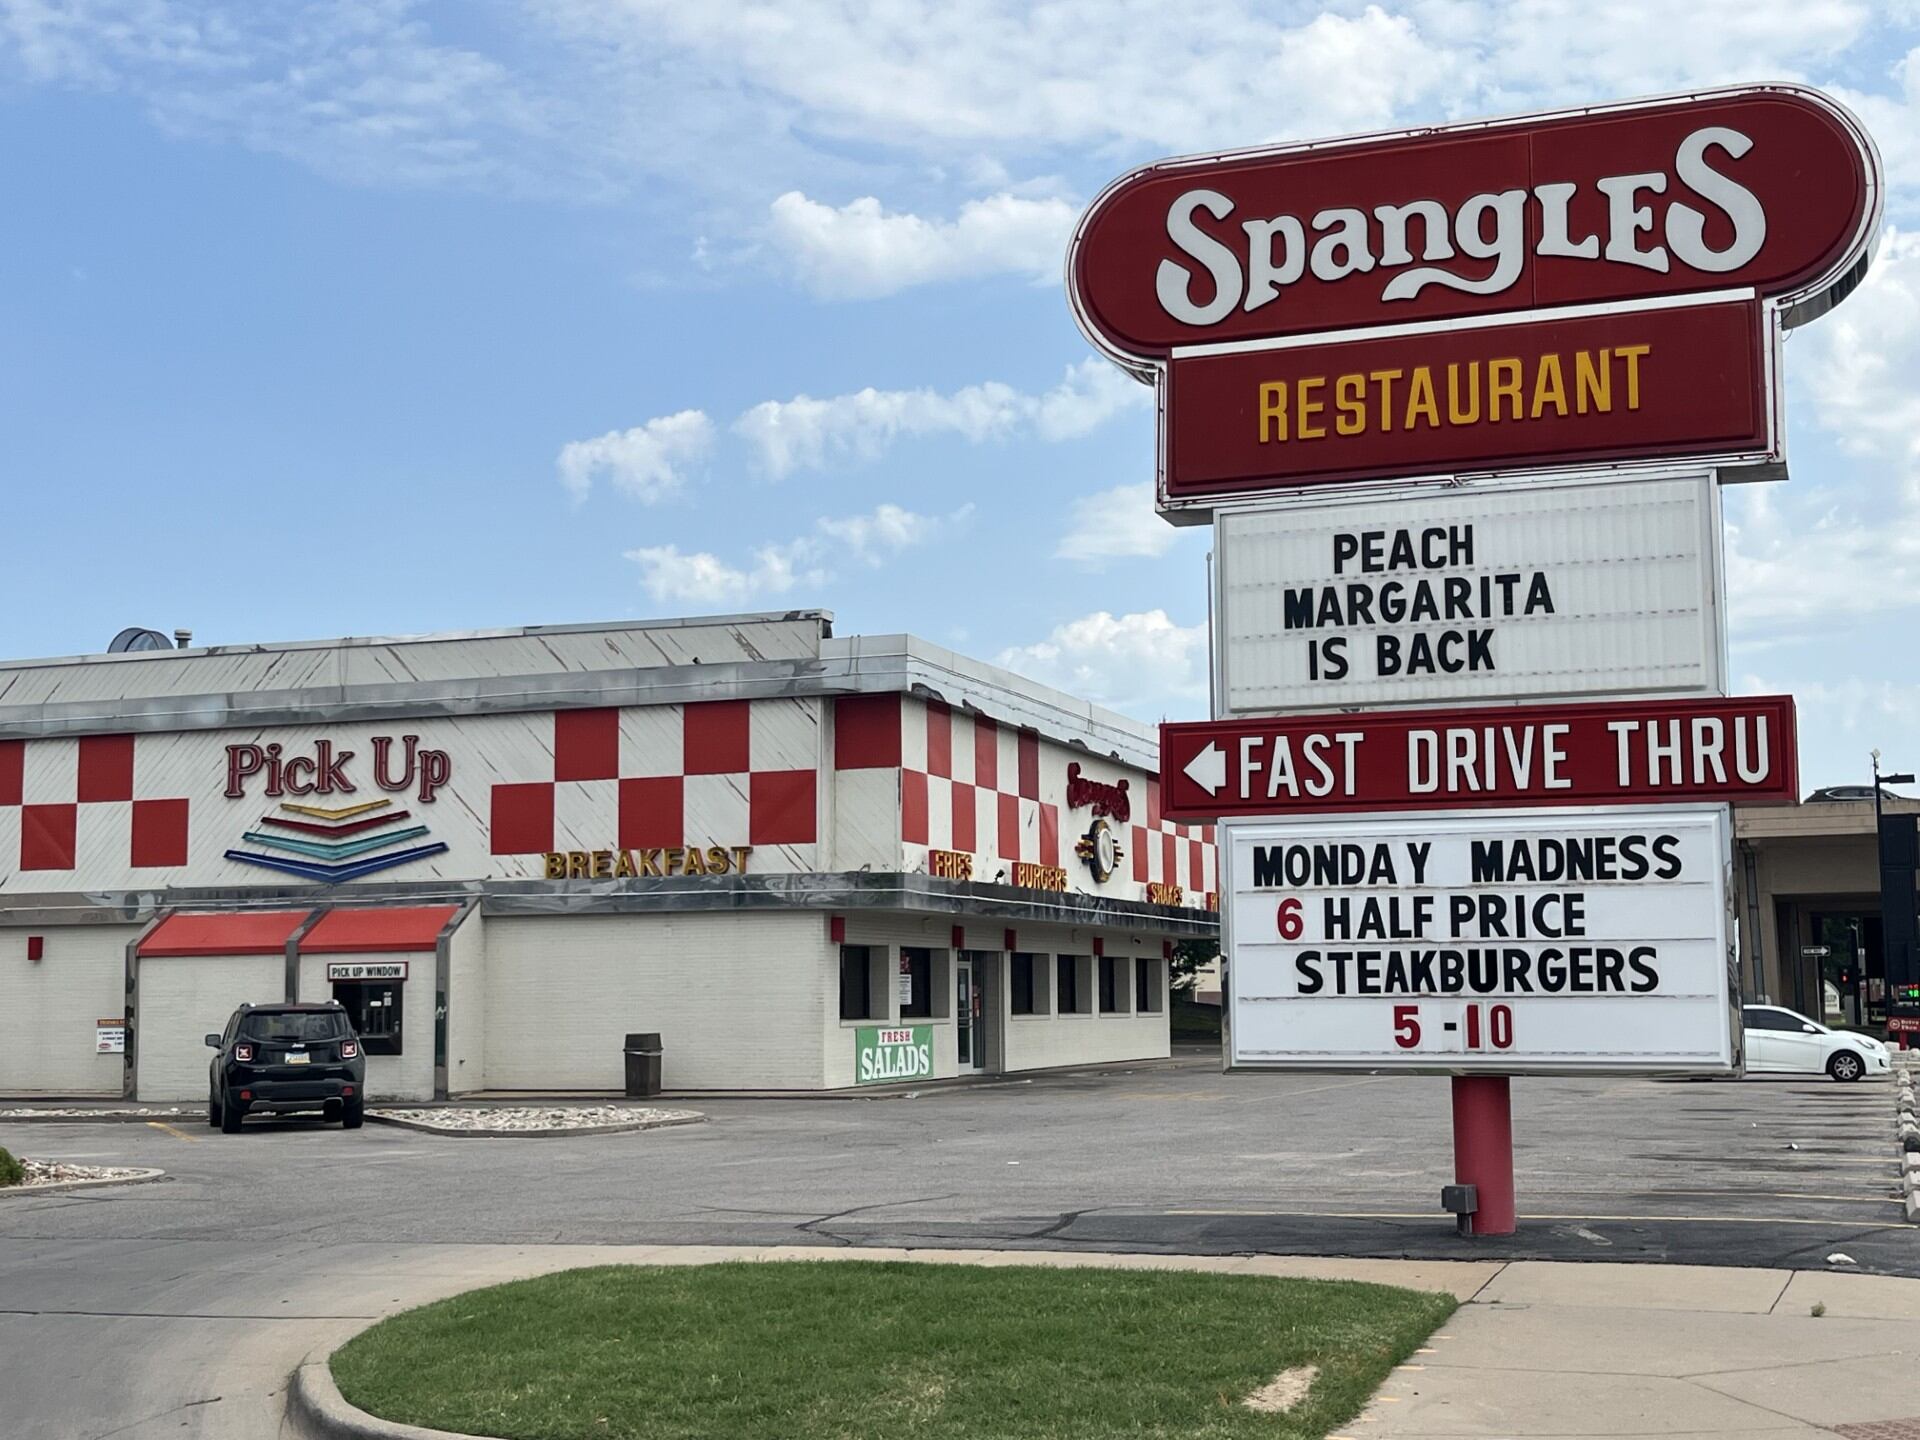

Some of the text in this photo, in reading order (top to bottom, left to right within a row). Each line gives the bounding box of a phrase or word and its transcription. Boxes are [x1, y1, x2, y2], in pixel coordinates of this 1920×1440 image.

[1258, 345, 1651, 443] RESTAURANT
[1334, 525, 1474, 574] PEACH
[1283, 571, 1555, 629] MARGARITA
[1308, 628, 1496, 680] IS BACK
[224, 734, 451, 803] Pick Up
[1238, 715, 1770, 799] FAST DRIVE THRU
[543, 845, 754, 880] BREAKFAST
[934, 850, 974, 881] FRIES
[1017, 863, 1068, 892] BURGERS
[1252, 834, 1682, 887] MONDAY MADNESS
[1276, 893, 1585, 940] 6 HALF PRICE
[332, 965, 402, 977] PICK UP WINDOW
[1295, 946, 1659, 994] STEAKBURGERS
[881, 1031, 911, 1043] FRESH
[861, 1044, 930, 1080] SALADS
